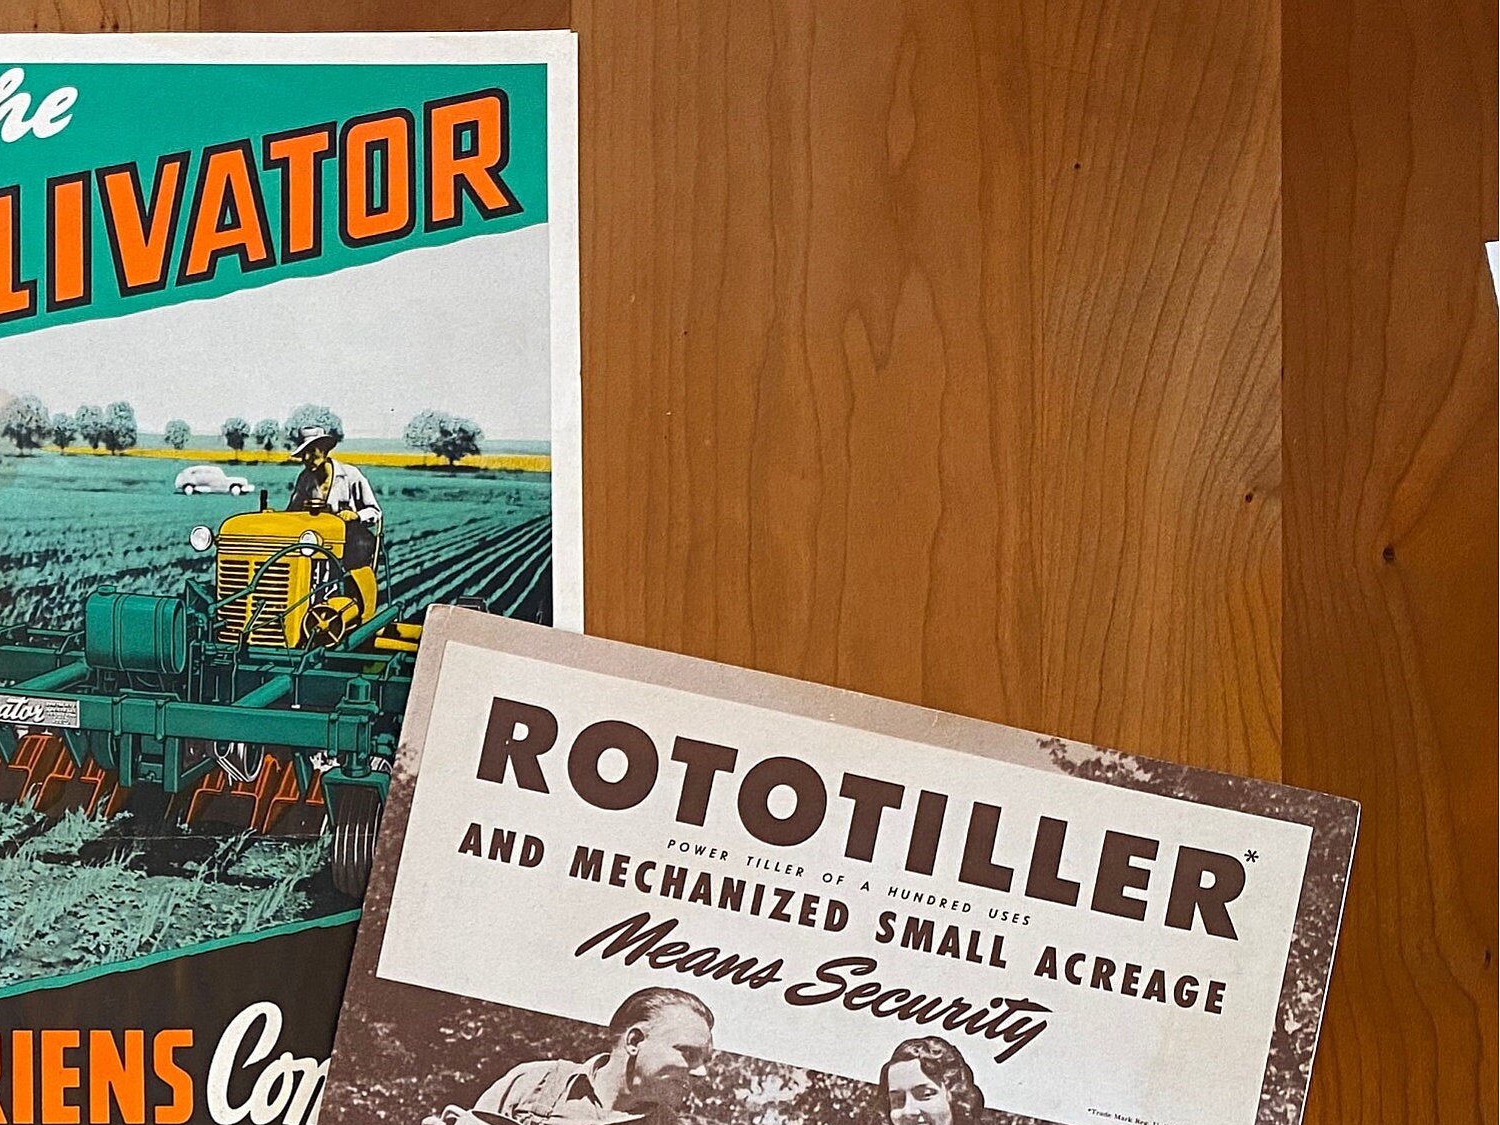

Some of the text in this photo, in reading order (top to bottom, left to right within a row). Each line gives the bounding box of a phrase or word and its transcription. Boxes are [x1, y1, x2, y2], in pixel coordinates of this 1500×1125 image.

[458, 821, 1228, 1015] AND MECHANIZED SMALL ACREAGE
[667, 839, 1031, 926] POWER TILLER OF A HUNDRED USES
[574, 910, 1052, 1064] Means Security
[1114, 1113, 1133, 1123] Mark
